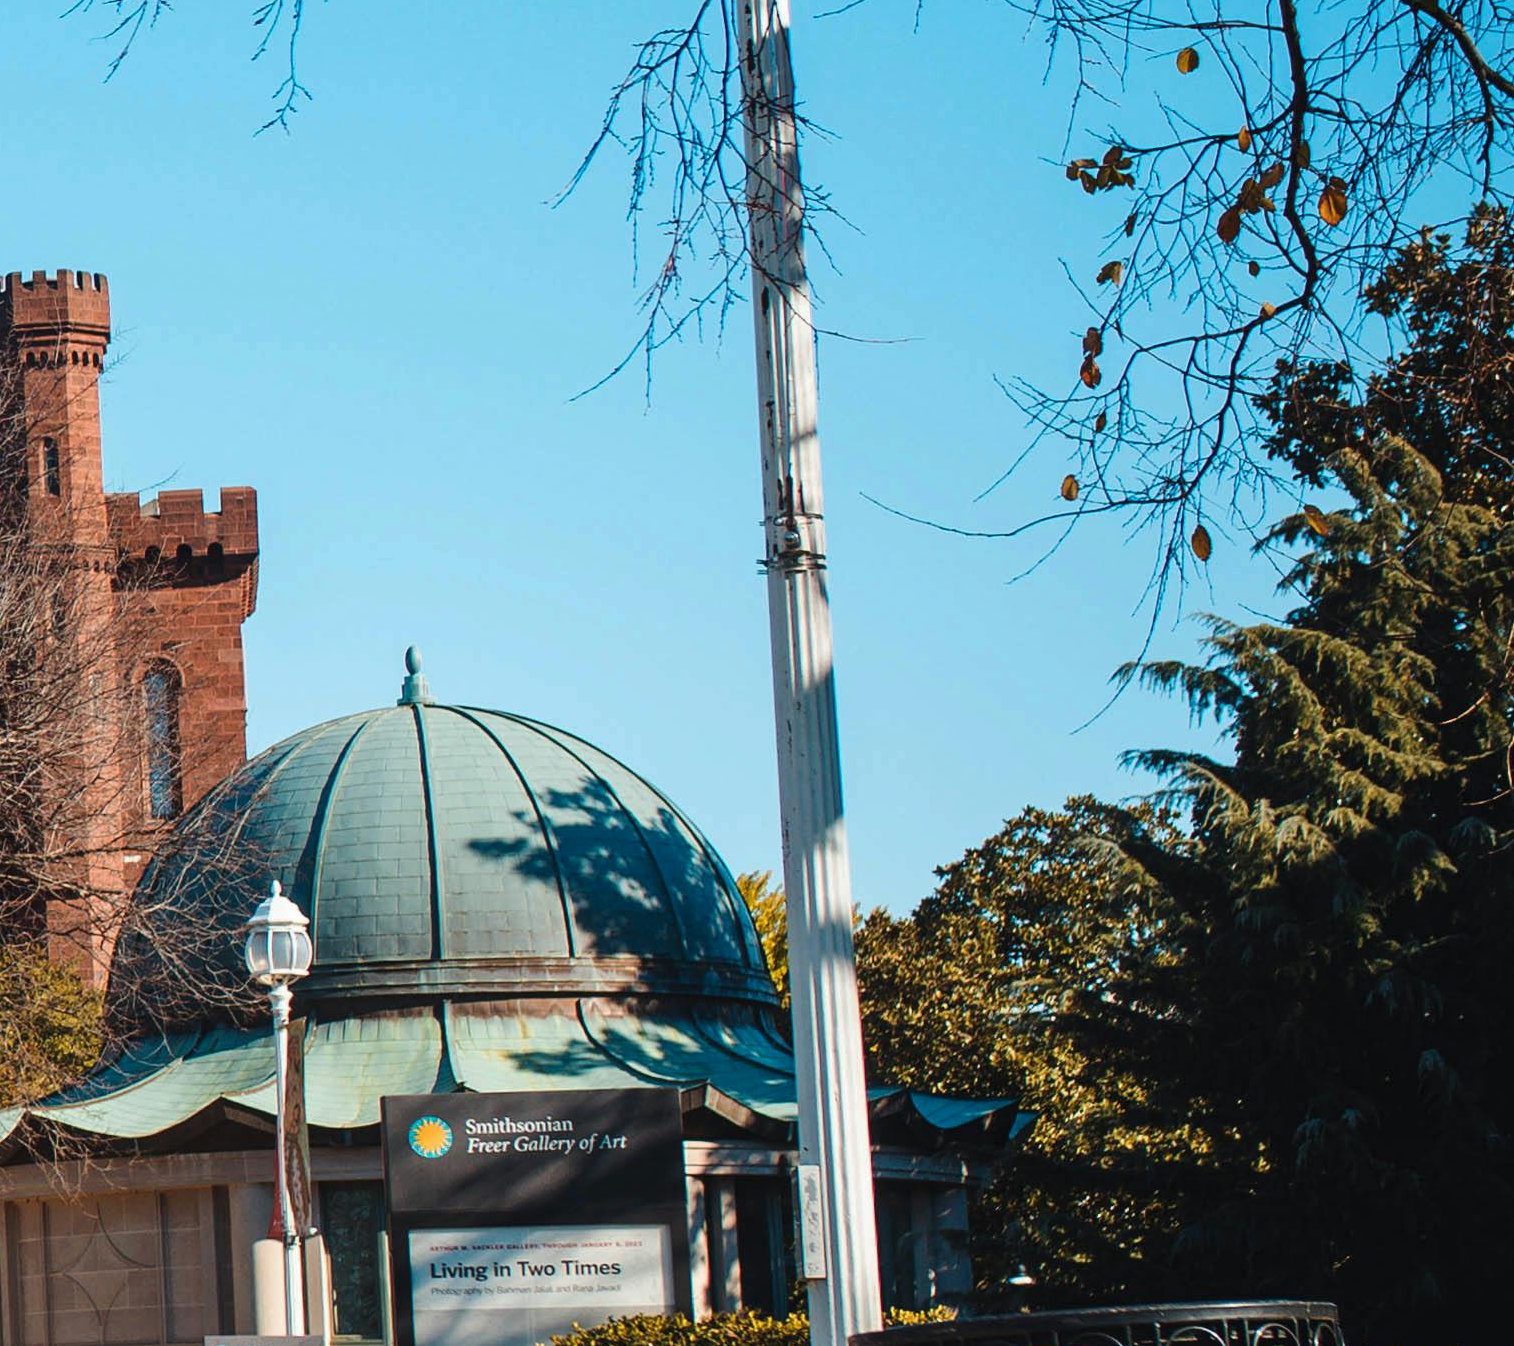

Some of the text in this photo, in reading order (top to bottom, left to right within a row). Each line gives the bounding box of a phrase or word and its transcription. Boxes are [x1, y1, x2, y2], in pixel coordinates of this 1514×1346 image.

[465, 1115, 574, 1135] Smithsonian
[467, 1133, 628, 1155] Freer Gallery of Art
[430, 1259, 622, 1282] Living in Two Times
